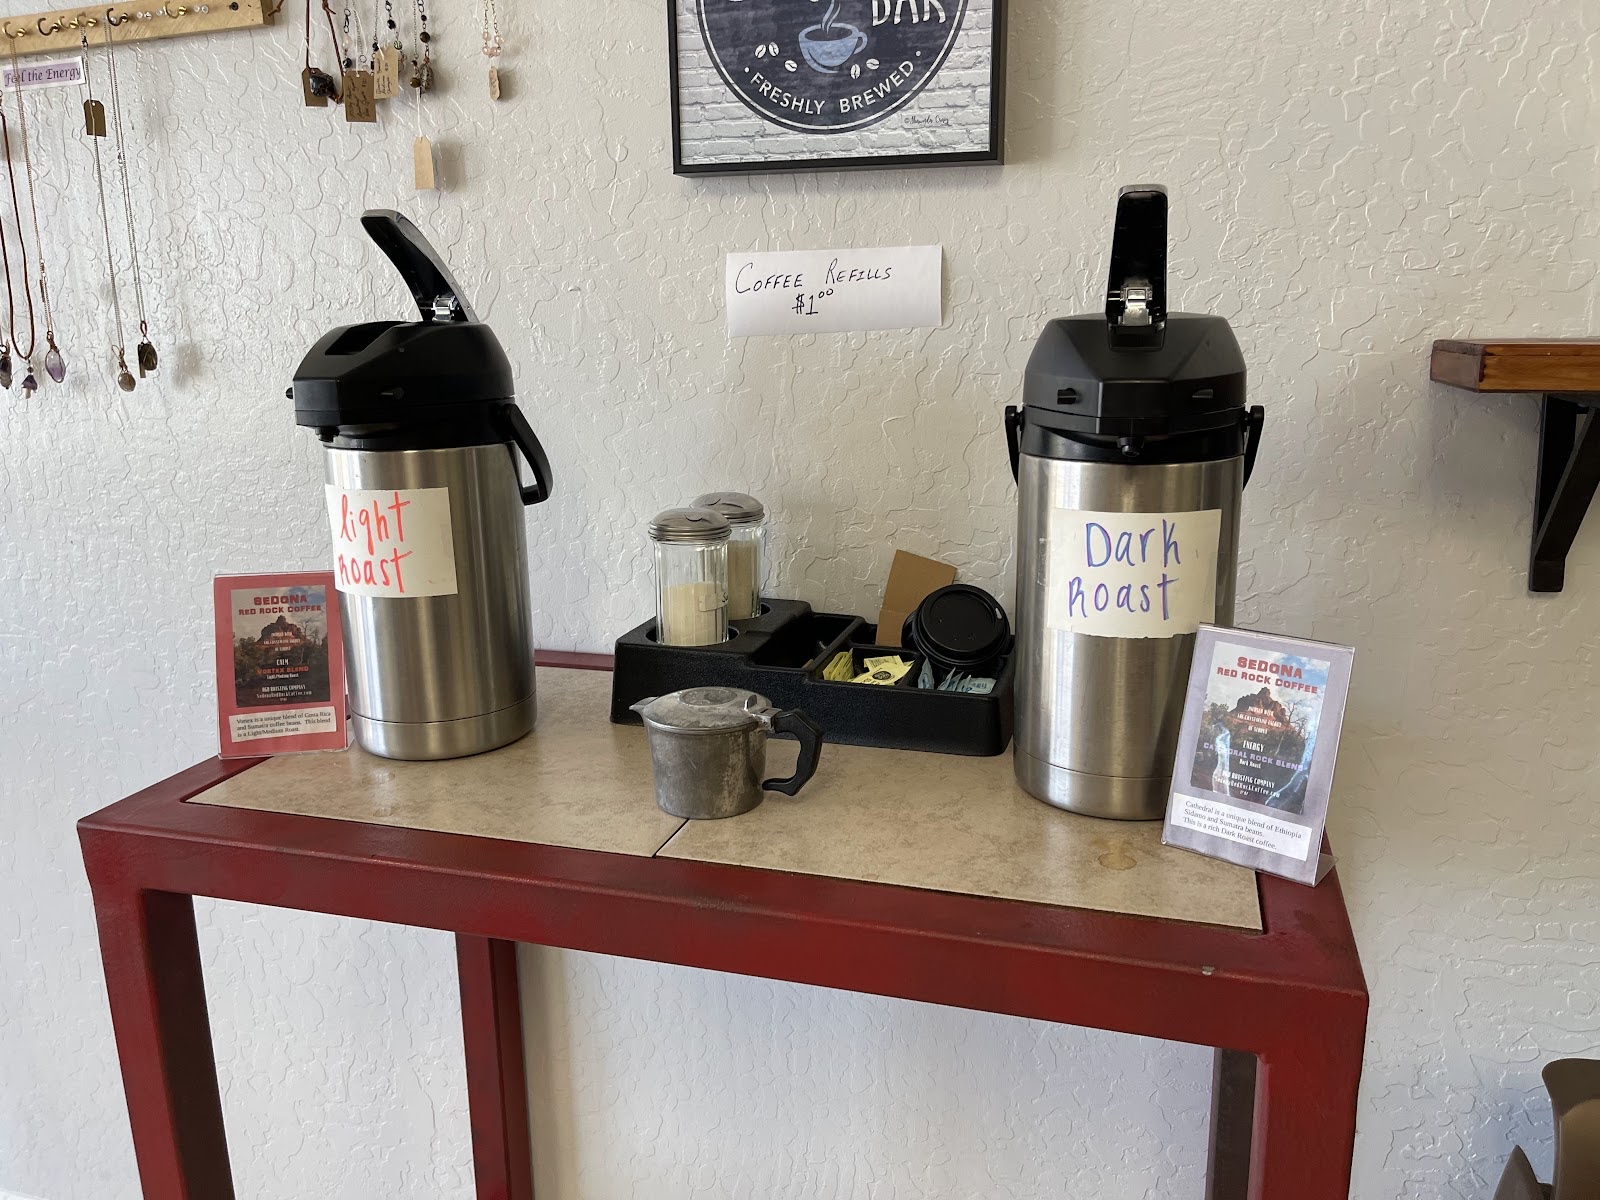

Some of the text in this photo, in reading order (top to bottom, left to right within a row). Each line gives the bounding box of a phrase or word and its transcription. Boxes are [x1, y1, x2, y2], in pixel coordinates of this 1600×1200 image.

[28, 69, 43, 81] the
[46, 67, 81, 81] Energy
[750, 60, 914, 115] FRESHLY BREWED
[340, 491, 411, 556] light
[1085, 518, 1181, 568] Dark
[253, 594, 308, 606] SEDONA
[1068, 573, 1180, 621] Roast
[238, 605, 322, 616] RED ROCK COFFEE
[256, 665, 310, 675] VORTEX BLEND
[1216, 666, 1318, 694] RED ROCK COFFEE
[1237, 656, 1303, 680] SEDONA
[1242, 739, 1265, 753] ENERGY
[1249, 753, 1274, 764] ROCK
[1275, 759, 1304, 772] BLEND
[1185, 800, 1214, 814] Cathedral
[1226, 812, 1247, 823] unique
[1247, 817, 1266, 829] blend
[1274, 826, 1302, 839] Ethiopia
[1207, 816, 1219, 824] and
[1219, 818, 1244, 831] Sumatra
[1244, 825, 1265, 838] beans.
[1183, 816, 1196, 826] This
[1196, 820, 1202, 828] is
[1207, 824, 1220, 833] rich
[1220, 827, 1236, 838] Dark
[1236, 832, 1255, 843] Roast
[1255, 839, 1277, 850] coffee.
